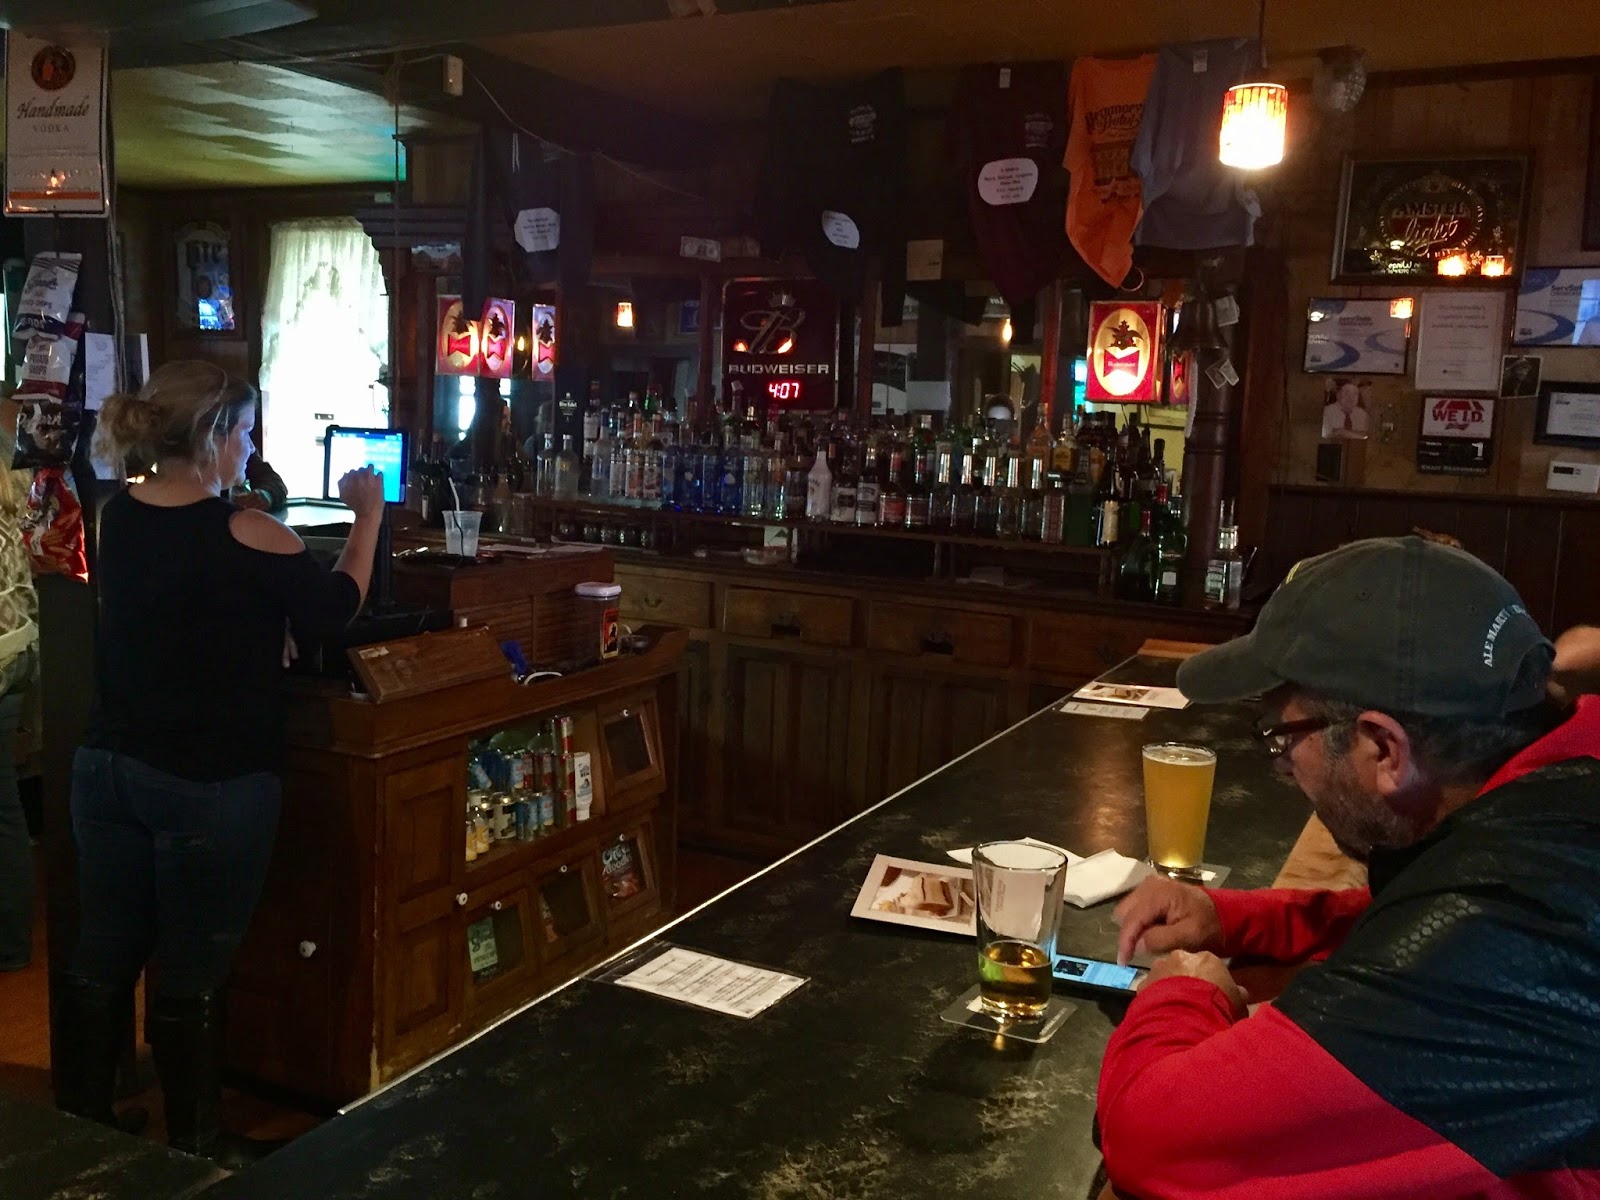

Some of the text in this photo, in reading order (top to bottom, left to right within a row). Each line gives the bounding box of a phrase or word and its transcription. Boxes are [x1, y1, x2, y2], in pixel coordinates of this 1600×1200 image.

[17, 96, 90, 119] Handmade
[33, 124, 70, 133] VODKA
[1403, 214, 1459, 257] light
[728, 363, 830, 375] BUDWEISER
[768, 382, 800, 400] 4:07
[1432, 410, 1457, 422] WE
